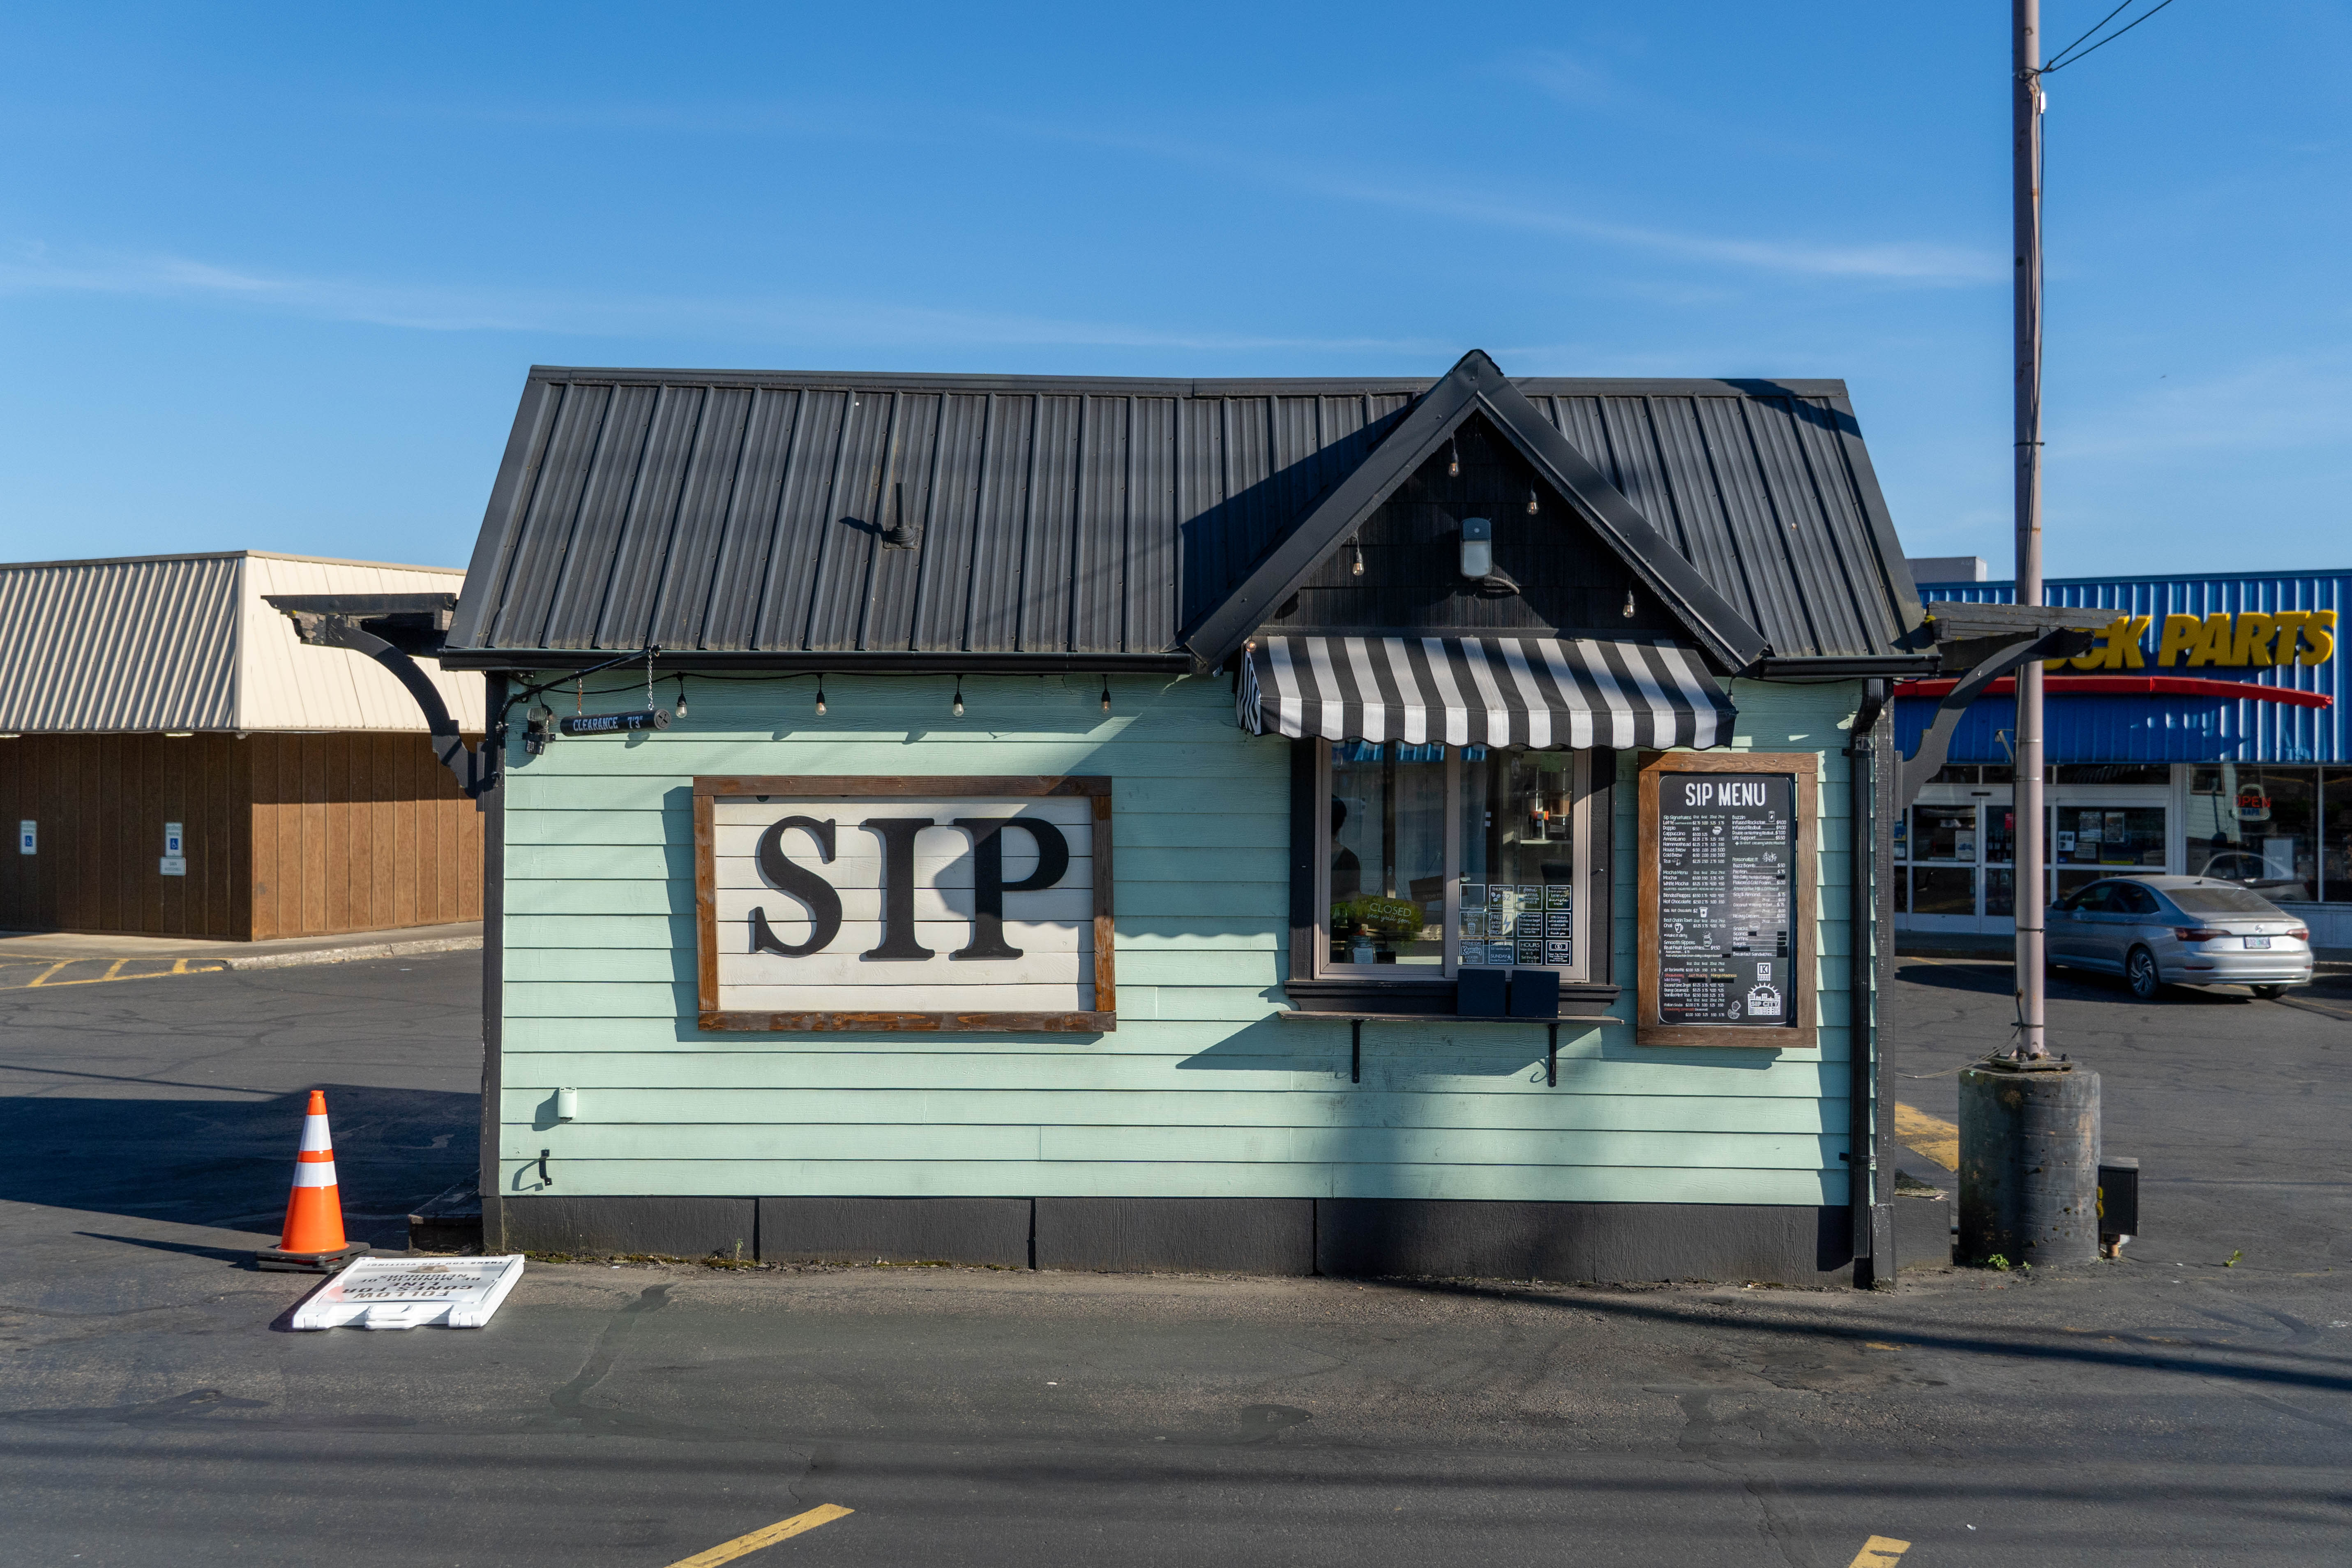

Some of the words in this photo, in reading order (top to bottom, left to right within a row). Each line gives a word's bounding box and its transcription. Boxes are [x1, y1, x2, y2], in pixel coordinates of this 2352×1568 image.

[2043, 615, 2153, 670] CK
[2157, 610, 2338, 666] PARTS
[573, 717, 618, 731] CLEARANCE
[628, 716, 643, 729] 7'3"
[1686, 783, 1712, 806] SIP
[1718, 782, 1765, 806] MENU
[2233, 796, 2271, 808] OPEN
[754, 816, 1069, 959] SIP
[1370, 903, 1411, 917] CLOSED
